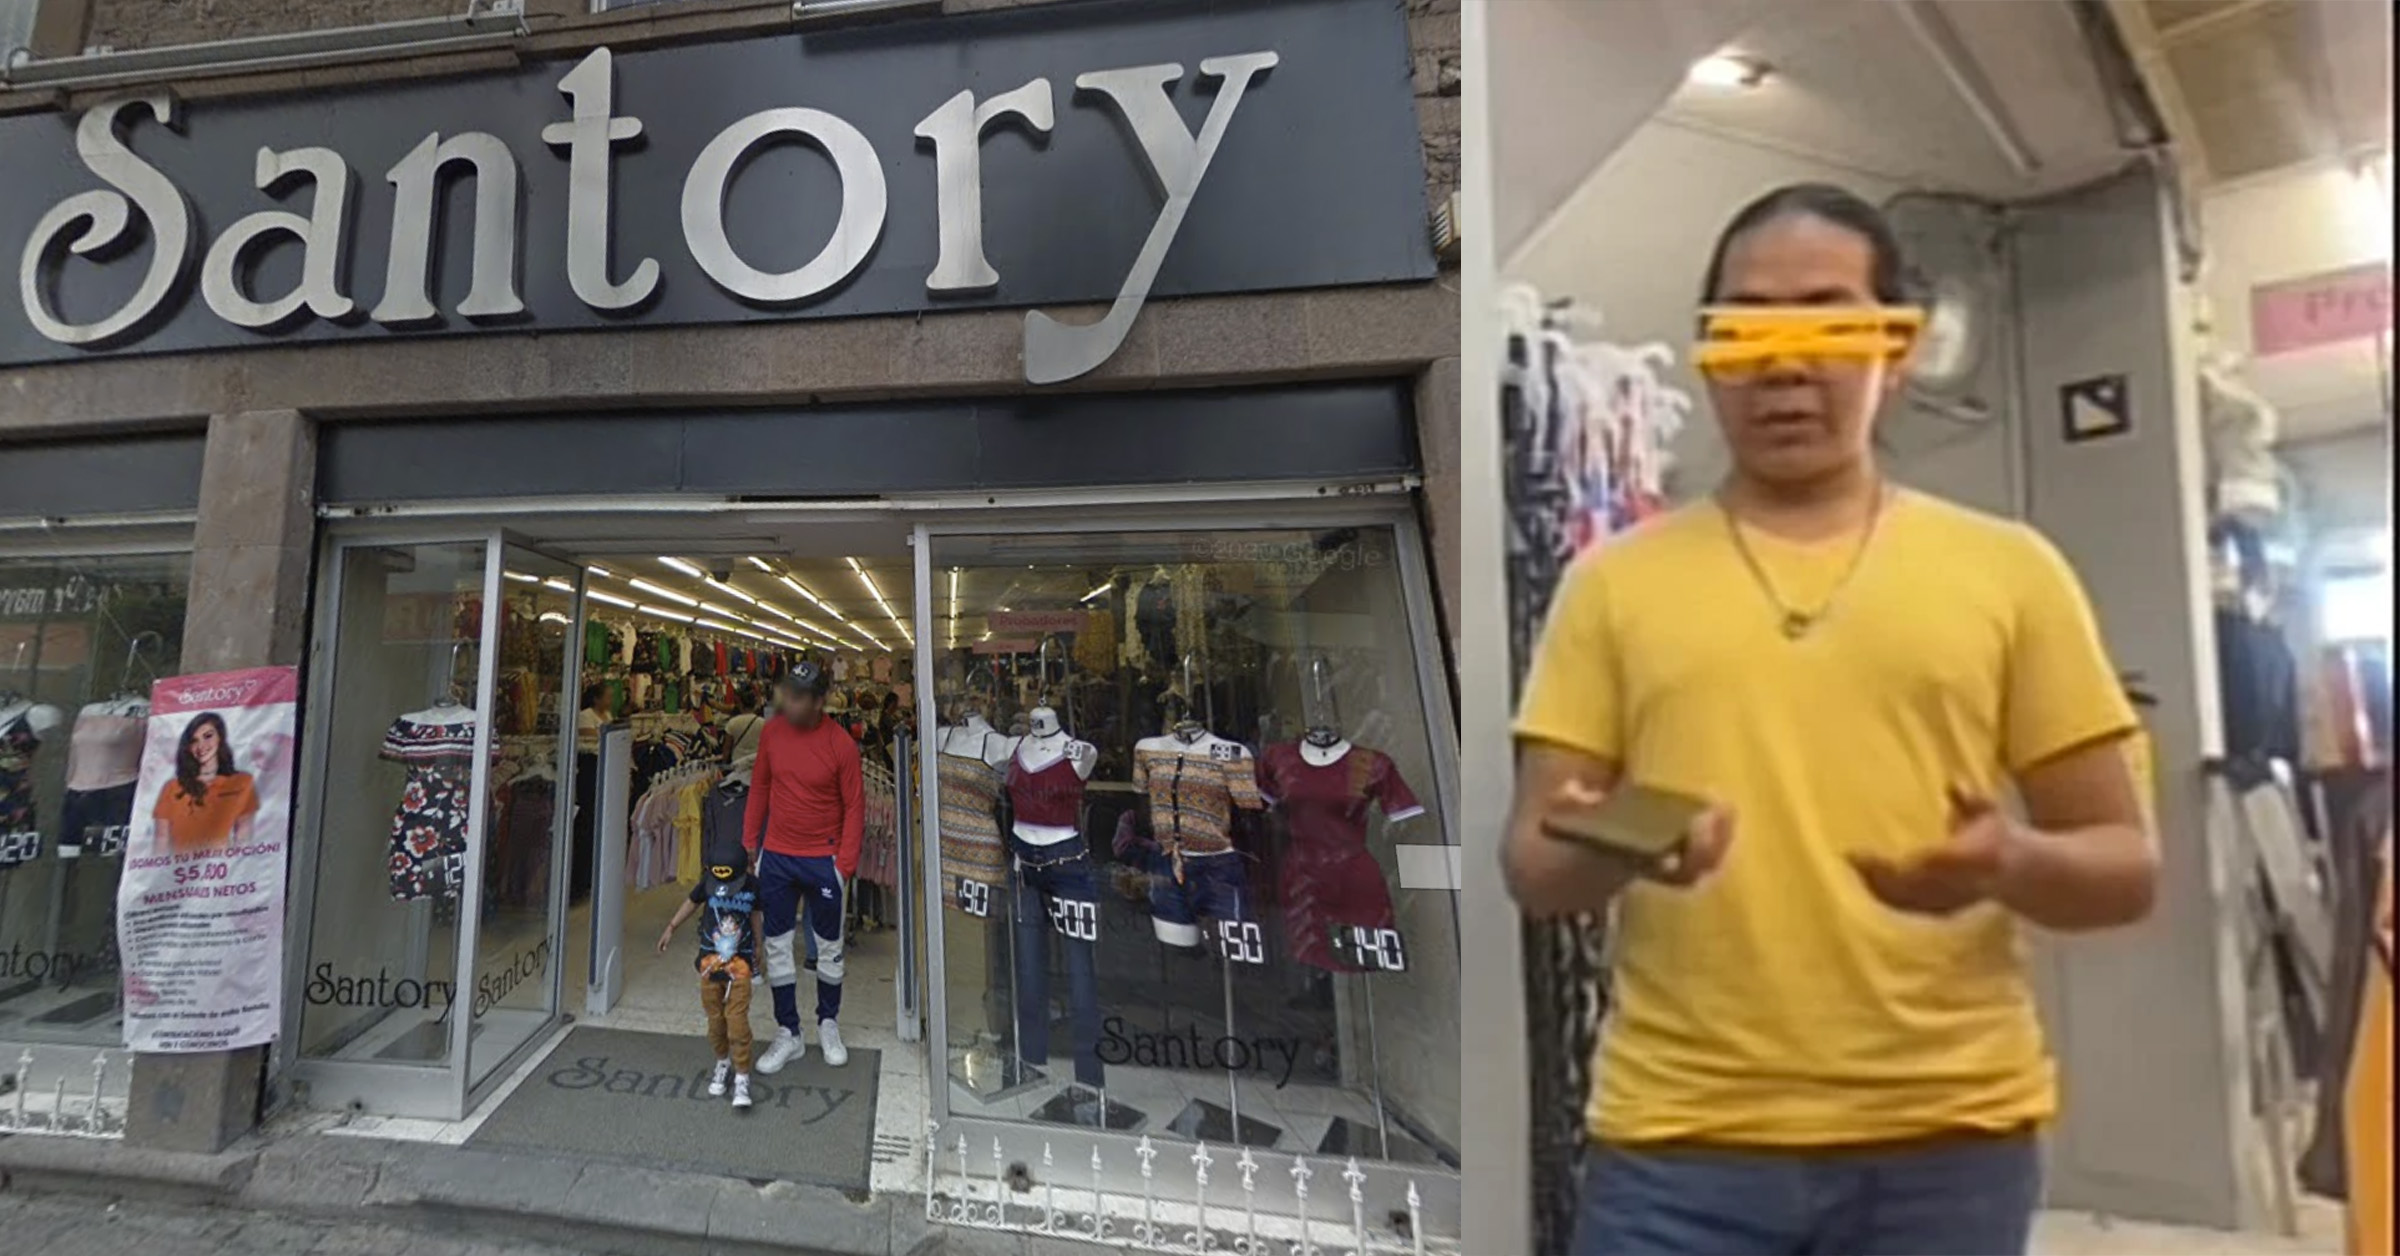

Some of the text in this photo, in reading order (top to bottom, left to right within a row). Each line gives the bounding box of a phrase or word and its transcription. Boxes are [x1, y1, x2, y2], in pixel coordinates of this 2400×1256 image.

[20, 46, 1279, 384] Santory
[213, 882, 257, 898] NETOS
[443, 853, 466, 885] 12
[305, 962, 457, 1025] Santory
[473, 934, 553, 1019] Santory
[1094, 1016, 1299, 1090] Santory
[547, 1056, 854, 1125] Santory
